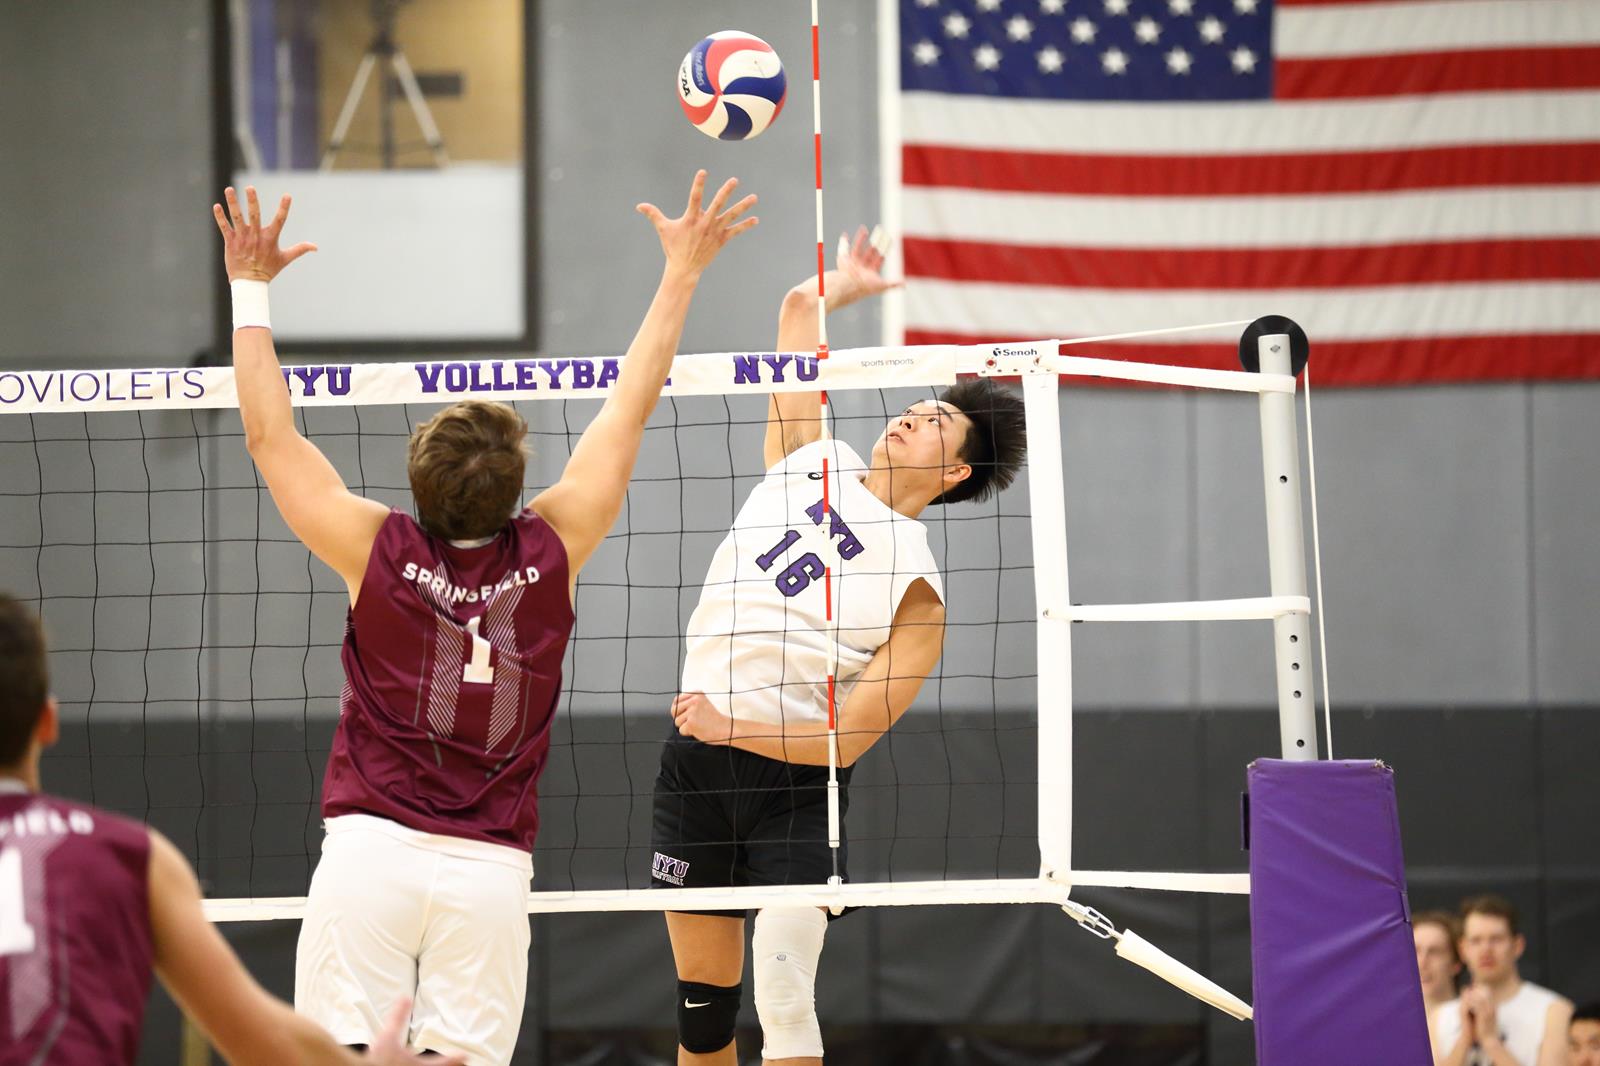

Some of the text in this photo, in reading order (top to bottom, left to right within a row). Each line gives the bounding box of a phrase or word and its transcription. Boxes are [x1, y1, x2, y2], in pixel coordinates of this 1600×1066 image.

[860, 357, 914, 368] sports imports
[1003, 348, 1039, 357] Senoh
[415, 358, 672, 393] VOLLEYBA
[733, 354, 820, 385] NYU
[755, 529, 826, 597] 16
[463, 616, 494, 684] 1
